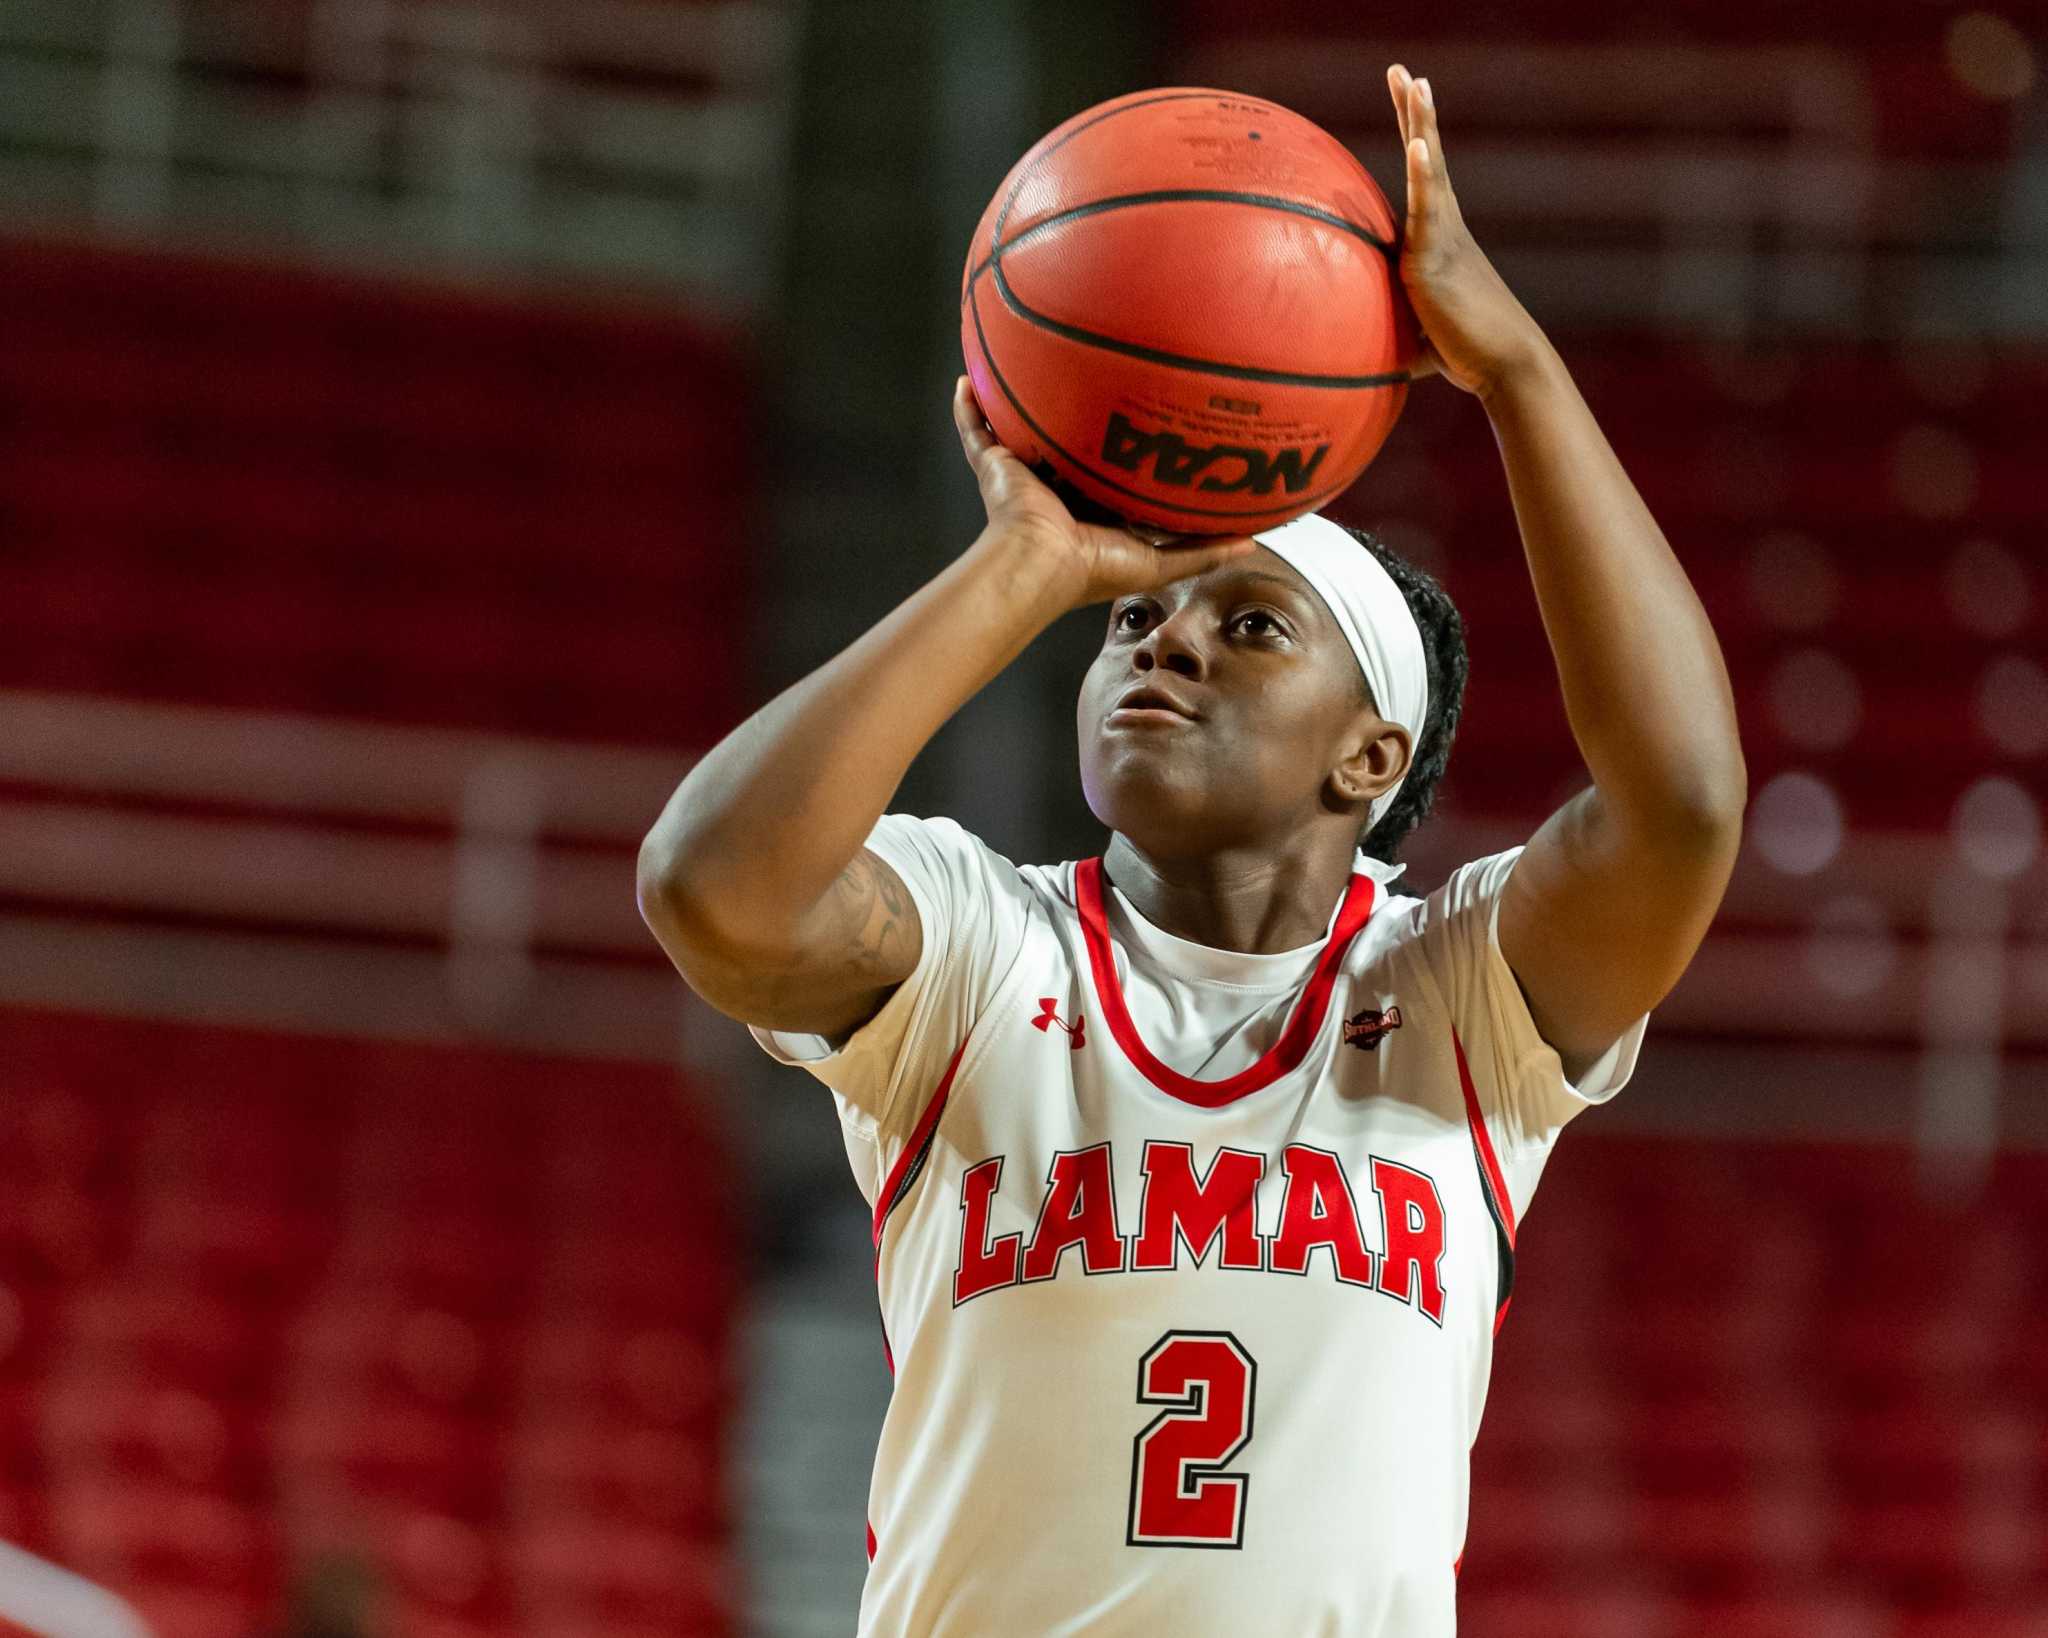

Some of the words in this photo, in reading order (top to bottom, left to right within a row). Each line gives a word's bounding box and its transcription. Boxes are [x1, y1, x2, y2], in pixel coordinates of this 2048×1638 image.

[1102, 411, 1332, 495] NCAA
[953, 1140, 1447, 1328] LAMAR
[1126, 1329, 1257, 1550] 2
